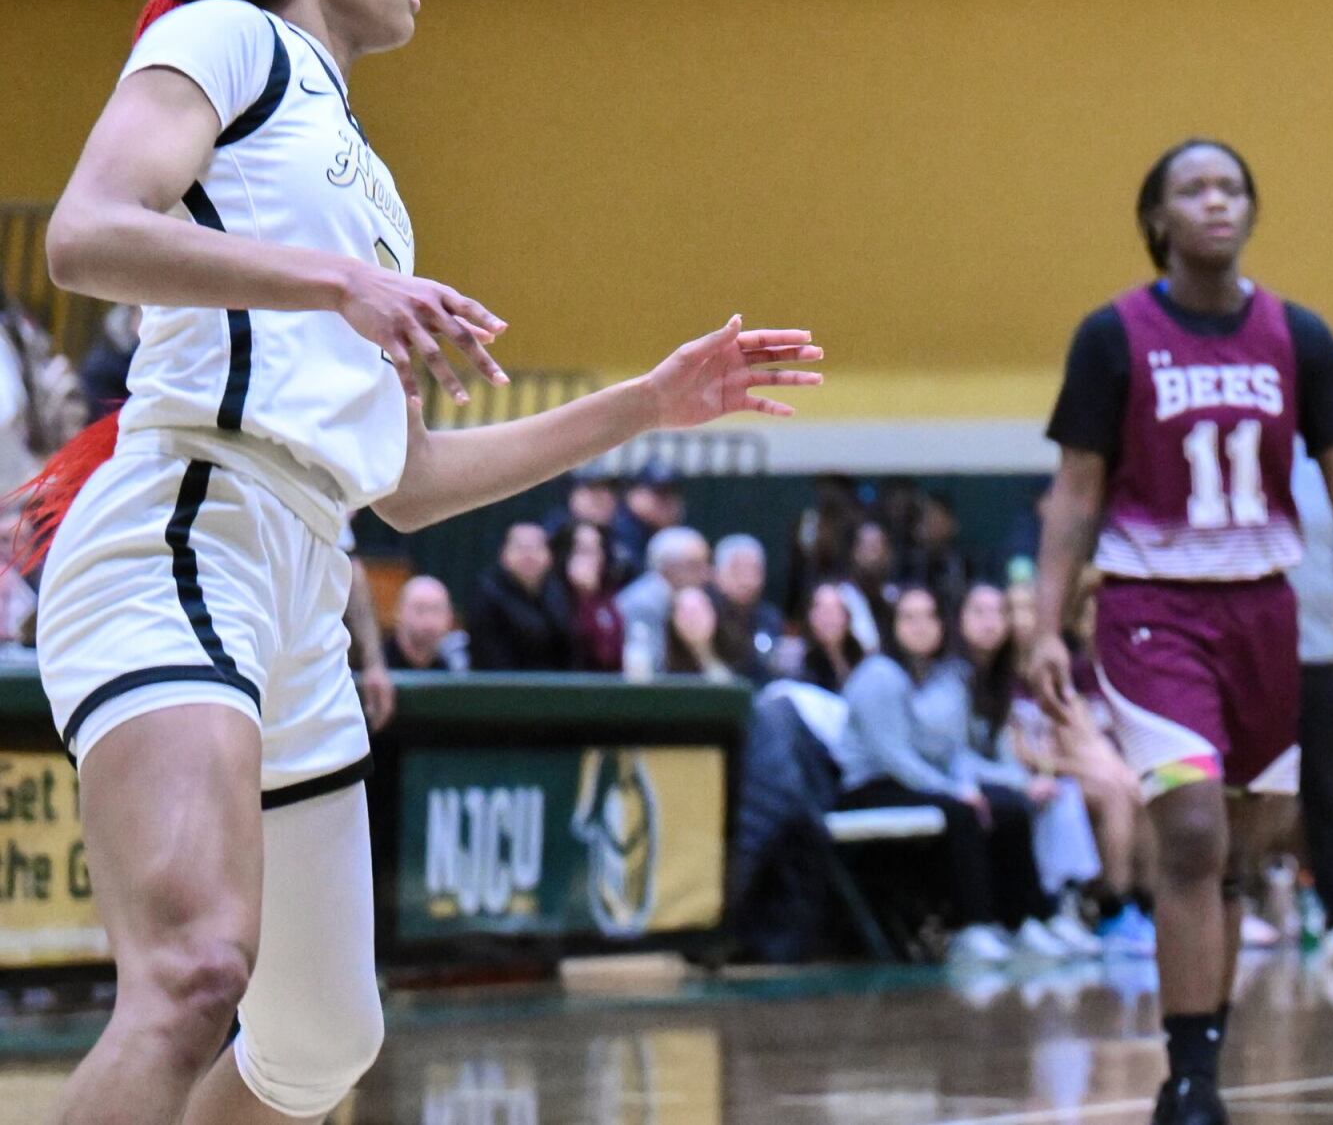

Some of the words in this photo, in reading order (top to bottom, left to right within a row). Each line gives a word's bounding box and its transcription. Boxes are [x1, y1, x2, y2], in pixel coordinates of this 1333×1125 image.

[1153, 363, 1284, 421] BEES
[1182, 419, 1270, 530] 11
[426, 786, 546, 916] NJCU
